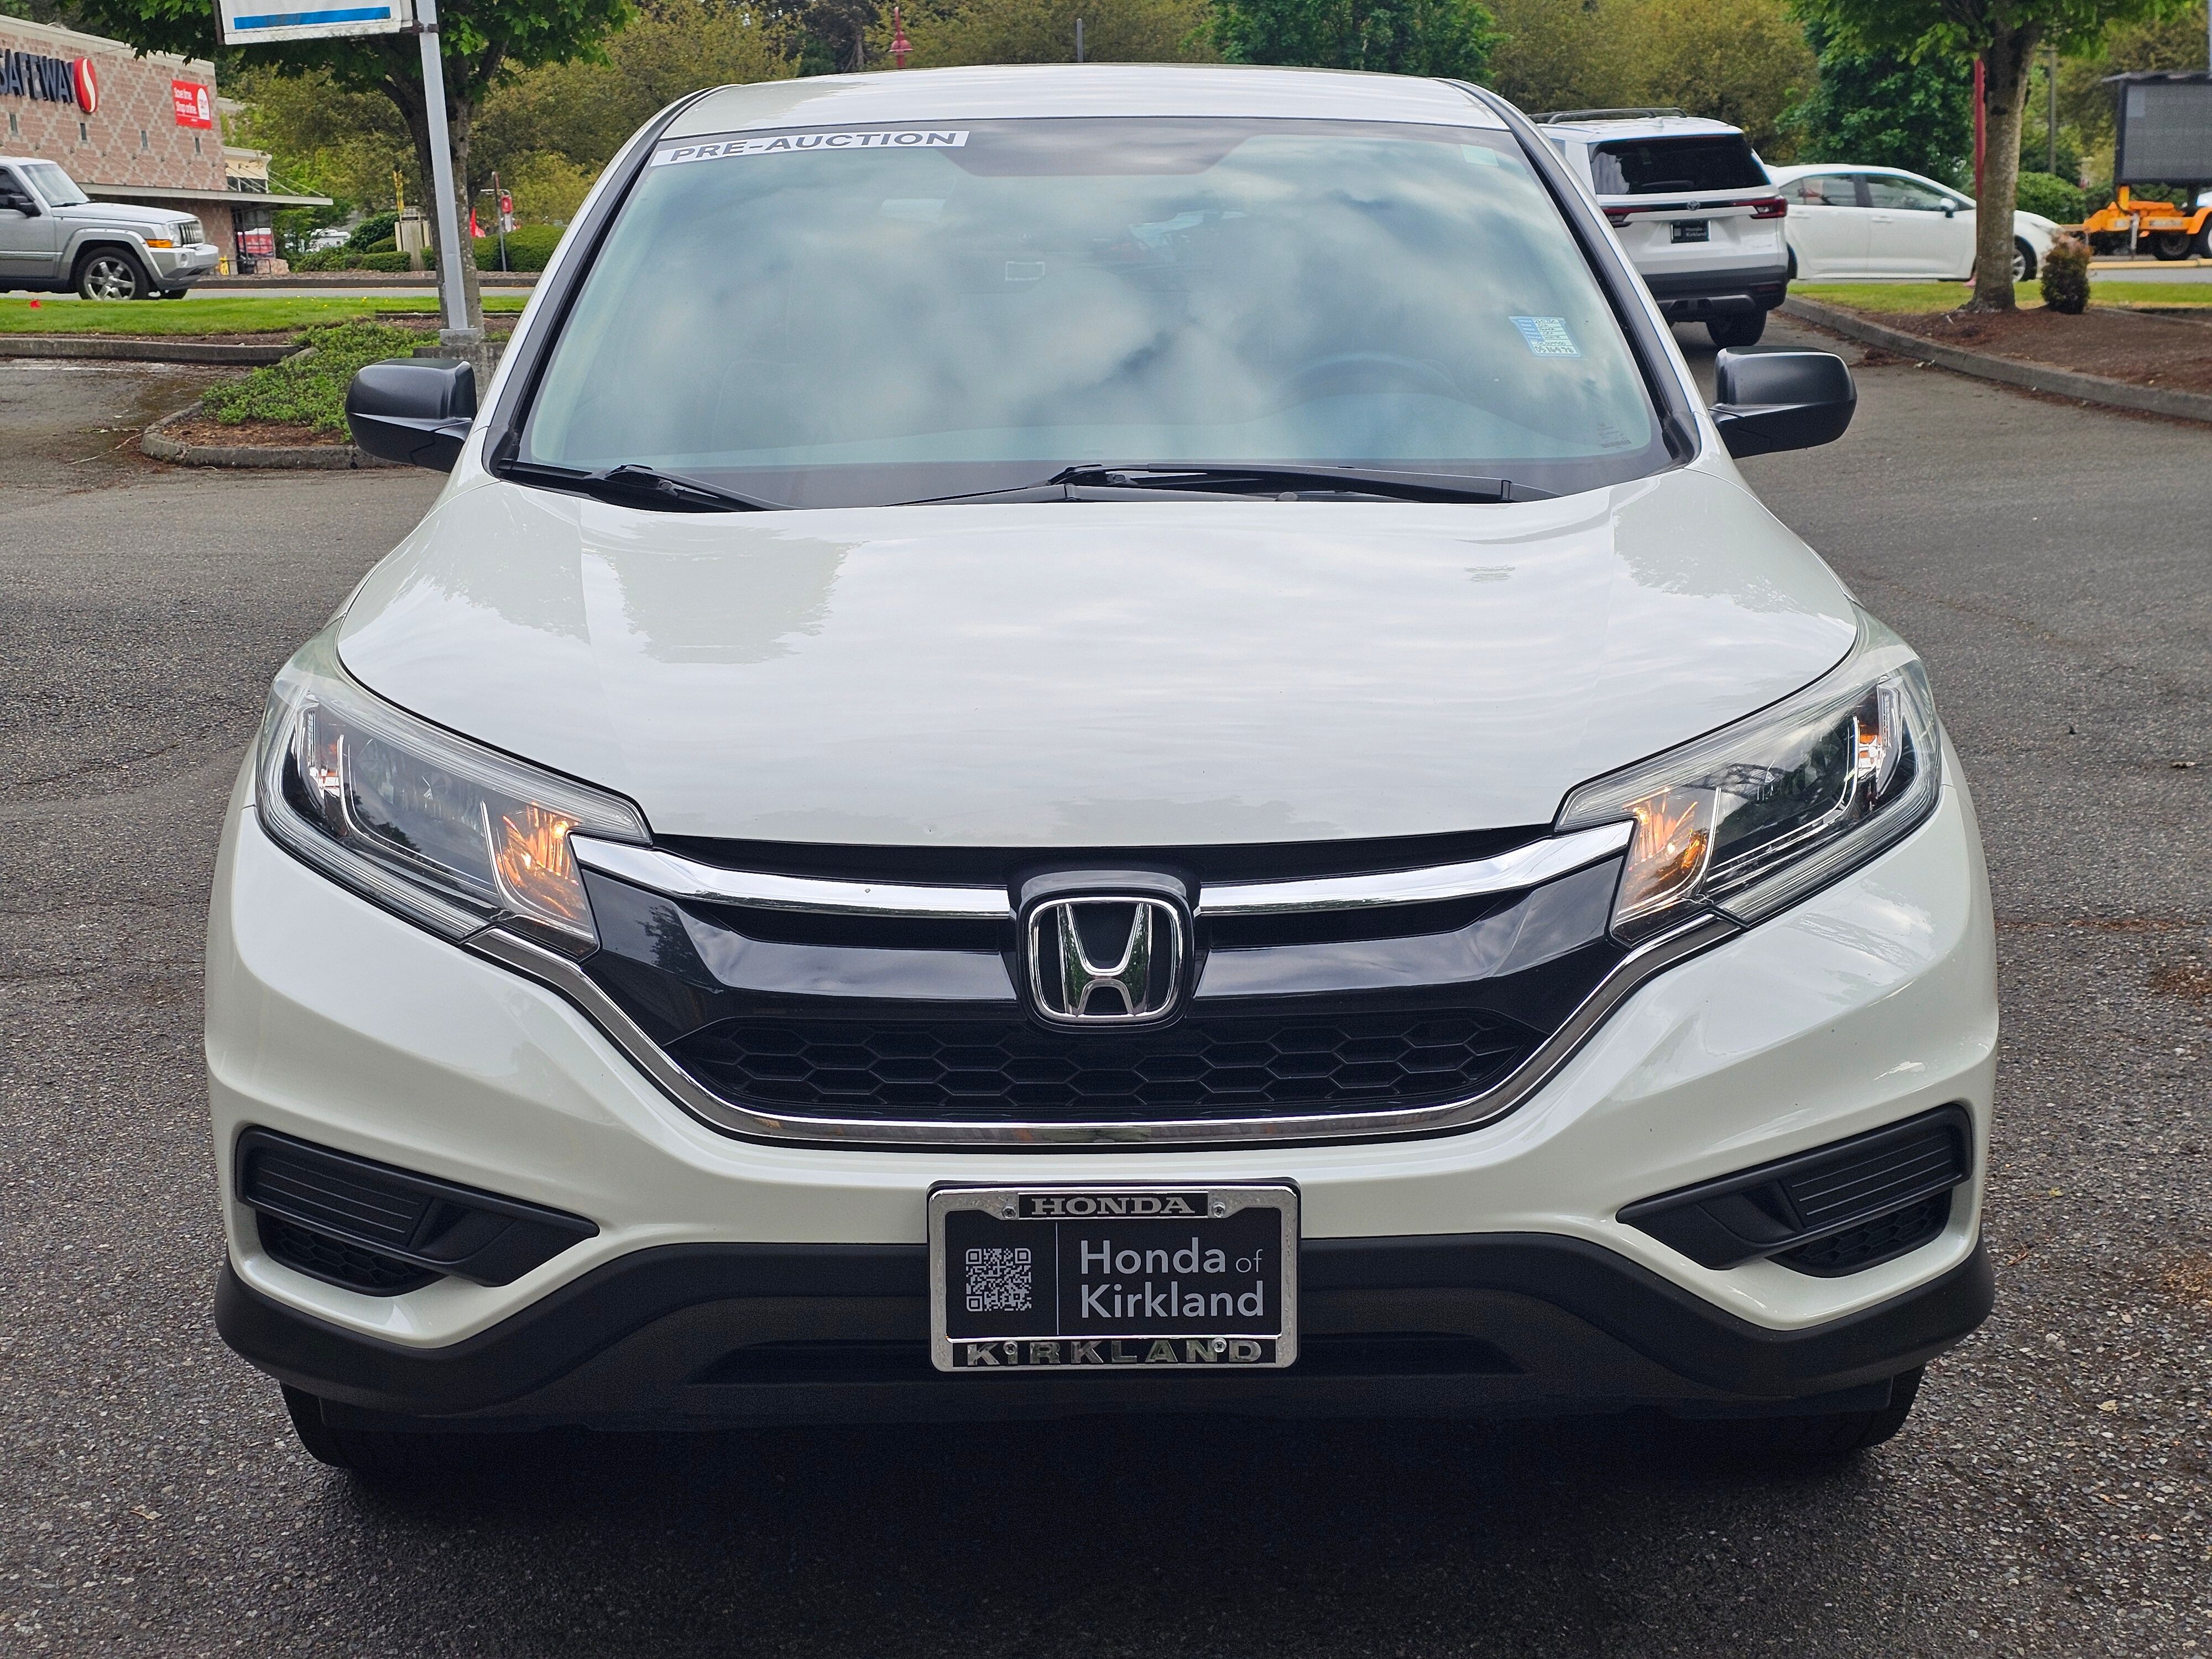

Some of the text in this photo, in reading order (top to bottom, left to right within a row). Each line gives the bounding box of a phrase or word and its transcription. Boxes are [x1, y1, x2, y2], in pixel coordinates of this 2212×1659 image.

[670, 133, 957, 161] PRE-AUCTION
[1031, 1197, 1195, 1215] HONDA
[1081, 1237, 1263, 1274] Honda of
[1081, 1280, 1264, 1318] Kirkland
